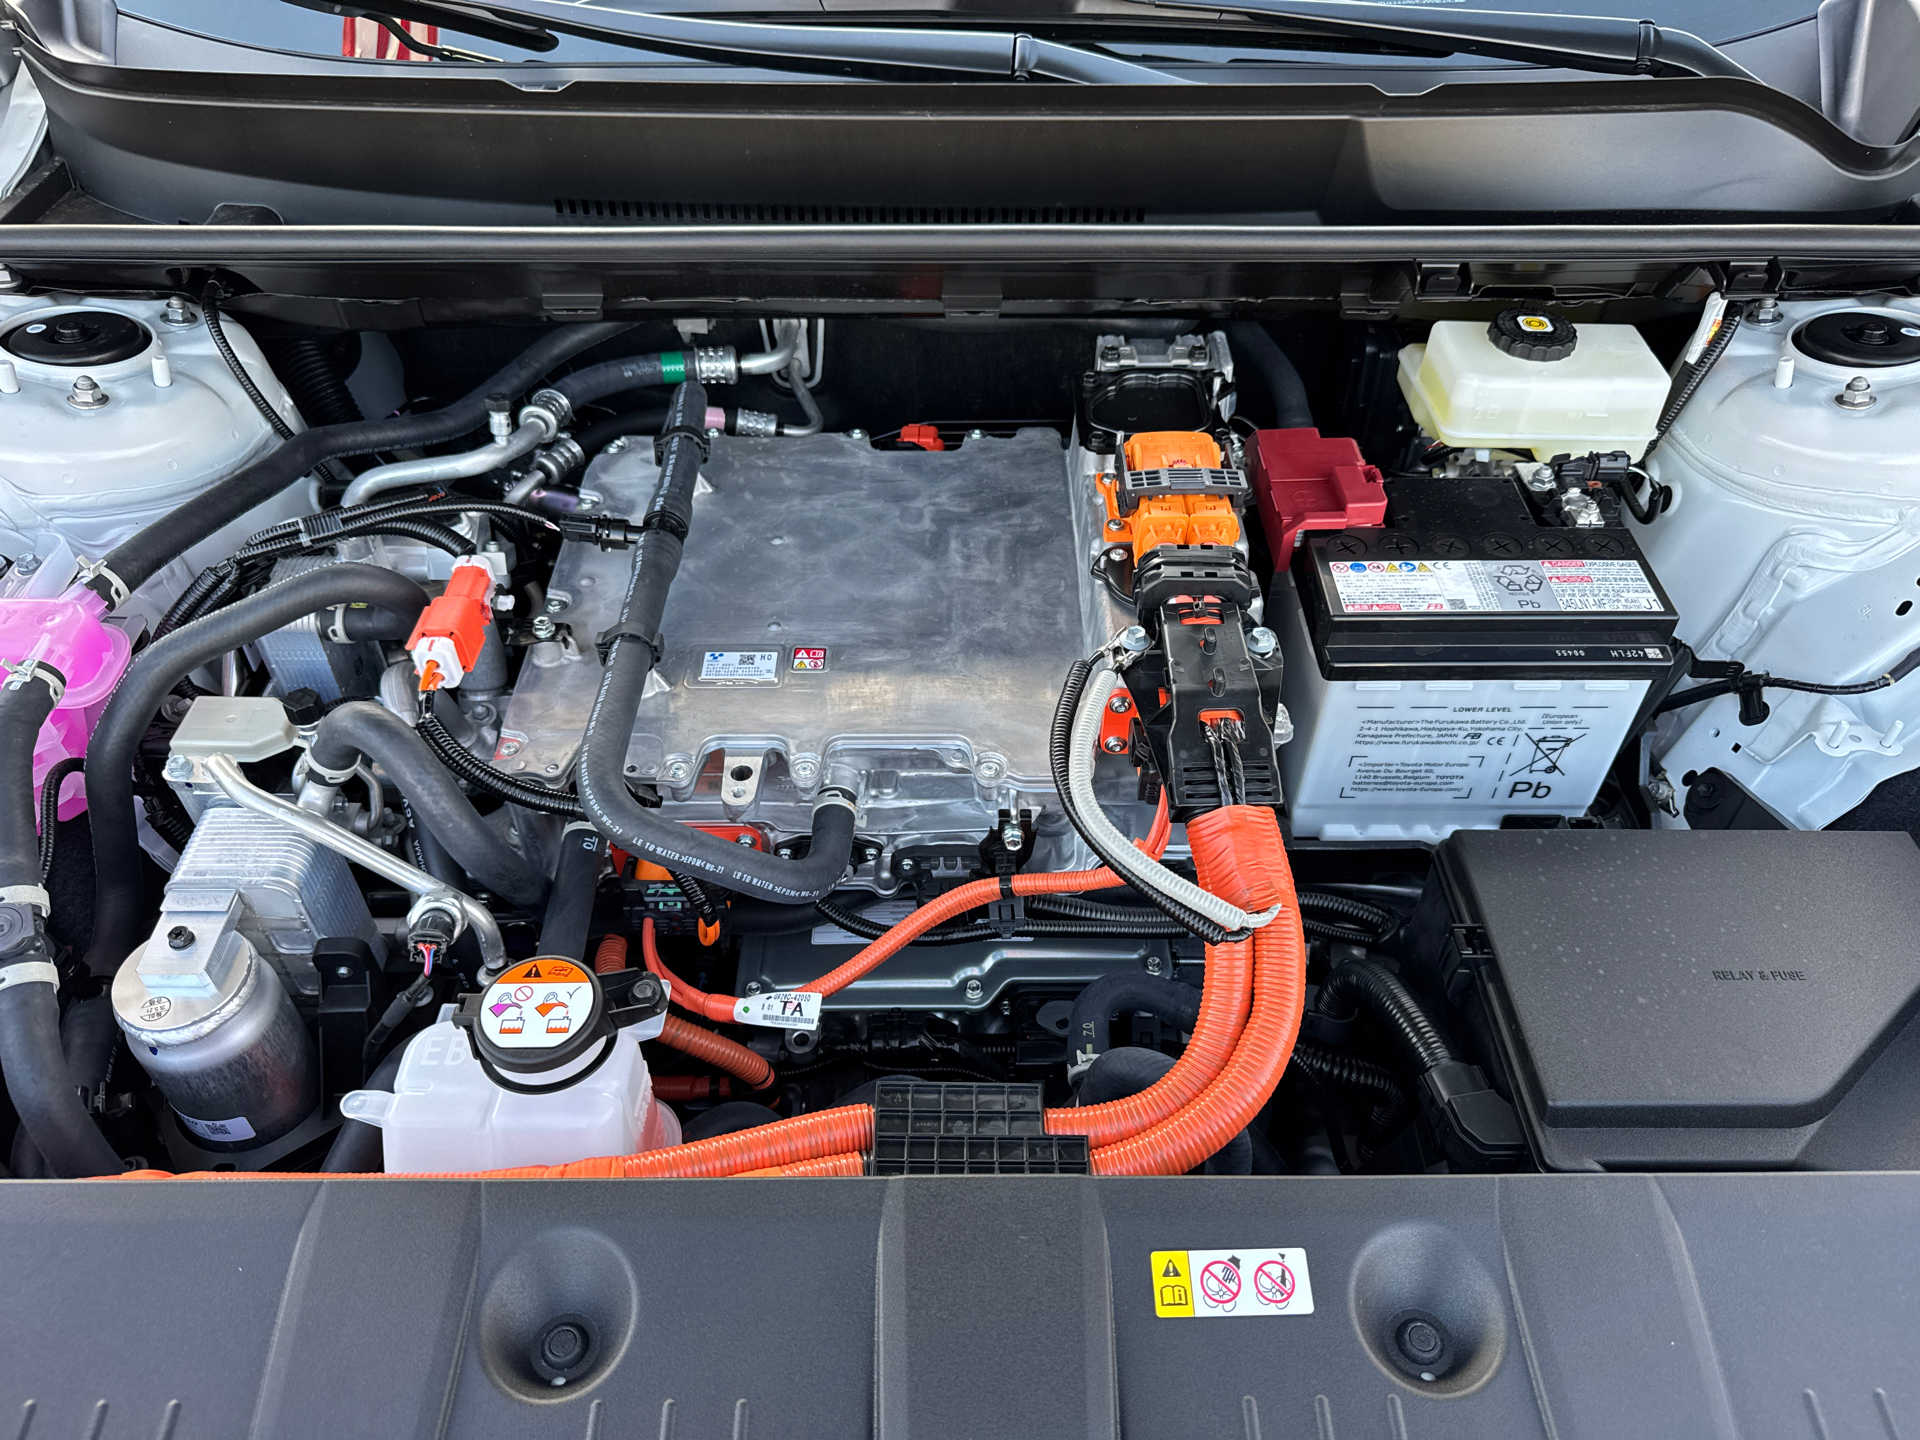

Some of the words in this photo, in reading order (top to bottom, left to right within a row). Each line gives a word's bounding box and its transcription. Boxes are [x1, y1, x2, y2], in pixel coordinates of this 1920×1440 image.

[1518, 600, 1541, 608] Pb
[1555, 649, 1585, 657] 00455
[1610, 649, 1644, 658] 42FLH
[581, 762, 589, 786] WATER
[1507, 781, 1551, 798] Pb
[632, 837, 643, 846] LE
[656, 846, 680, 860] WATER
[733, 870, 742, 879] LE
[751, 877, 774, 890] WATER
[1712, 970, 1754, 980] RELAY
[1758, 970, 1769, 980] &
[1770, 970, 1806, 980] FUSE
[779, 1000, 804, 1017] TA
[1082, 1022, 1094, 1036] 70
[420, 1036, 467, 1065] EB
